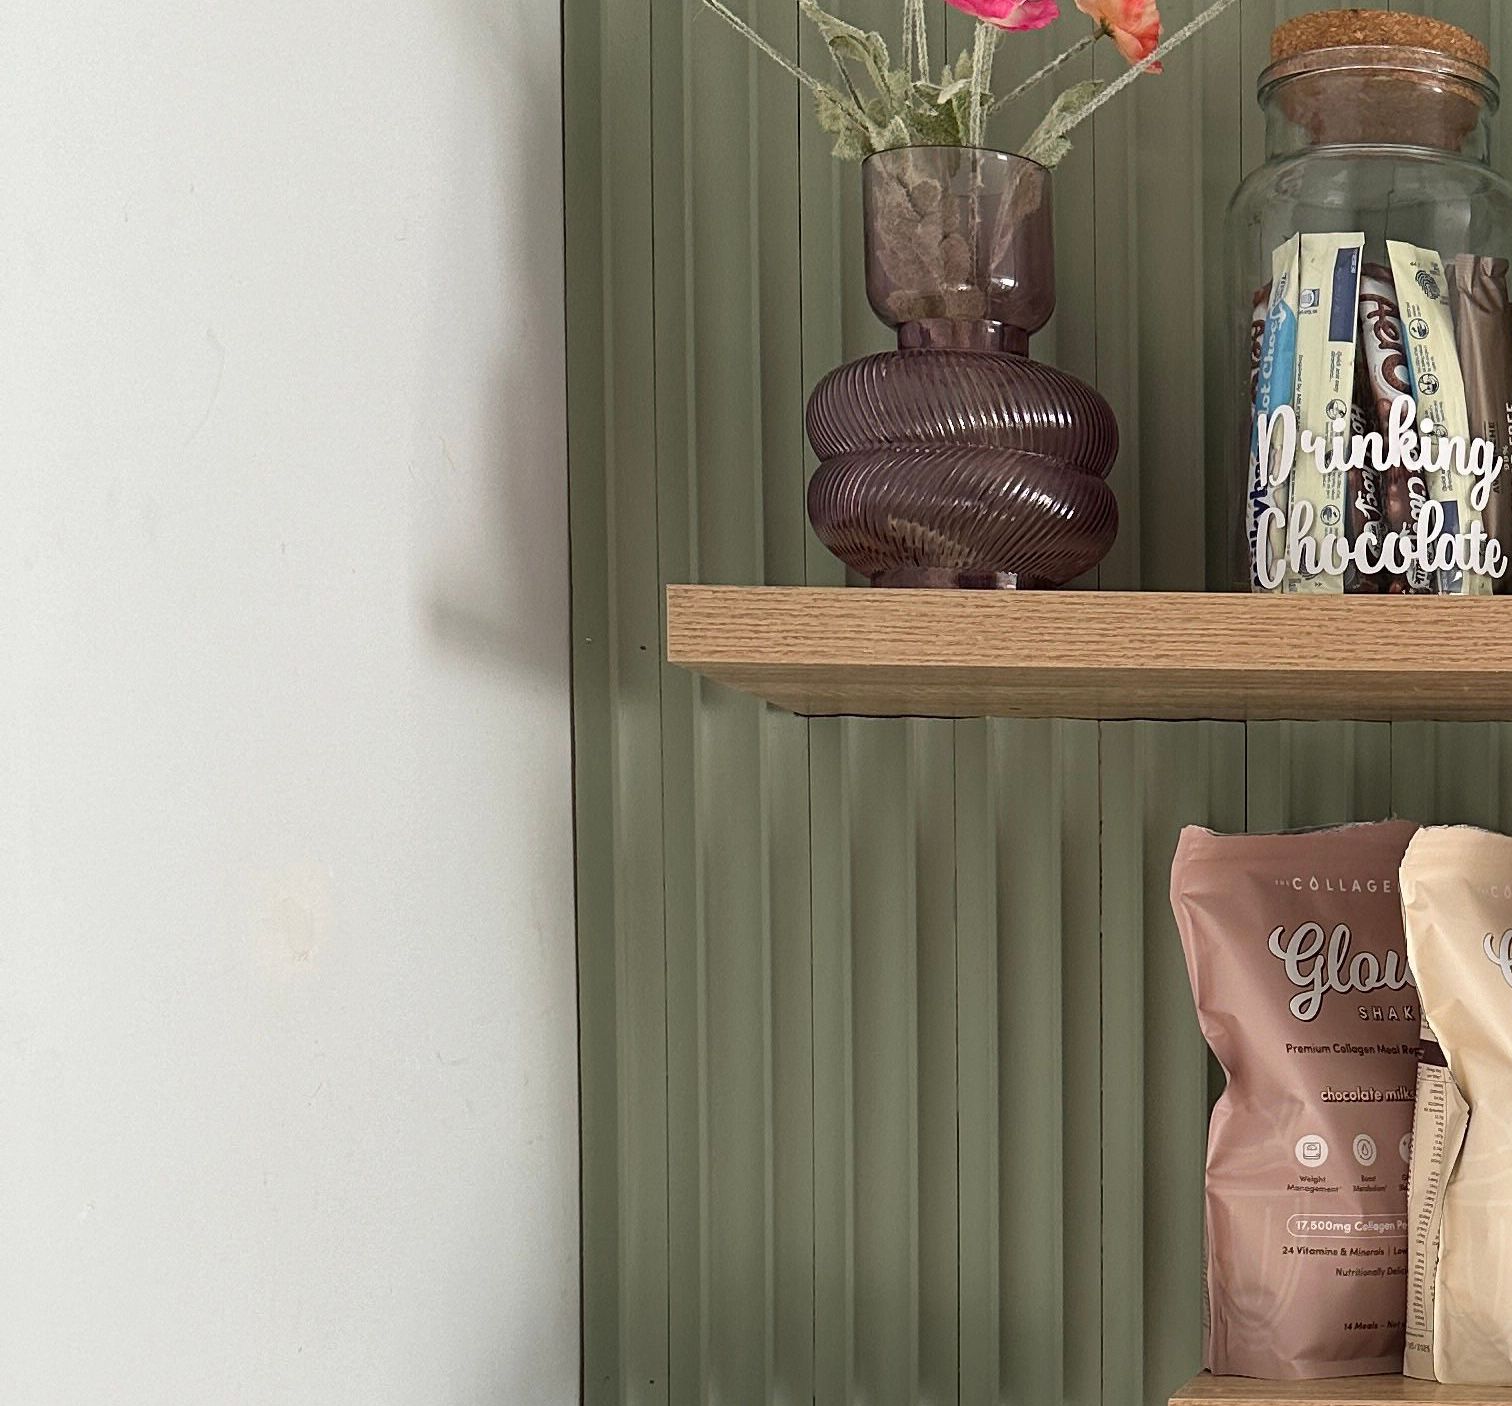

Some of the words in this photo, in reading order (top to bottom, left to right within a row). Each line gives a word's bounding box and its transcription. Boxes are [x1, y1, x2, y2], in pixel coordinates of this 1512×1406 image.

[1256, 394, 1503, 511] Drinking
[1256, 499, 1508, 589] Chocolate
[1286, 1043, 1331, 1054] Premium
[1333, 1043, 1376, 1056] Collagen
[1377, 1044, 1400, 1055] Meal
[1320, 1085, 1382, 1102] chocolate
[1300, 1174, 1326, 1184] Weight
[1296, 1220, 1351, 1233] 17,500mg
[1282, 1246, 1294, 1255] 24
[1297, 1246, 1338, 1256] Vitamins
[1350, 1247, 1385, 1256] Minerals
[1335, 1267, 1386, 1278] Nutritionally
[1354, 1322, 1378, 1331] Meals
